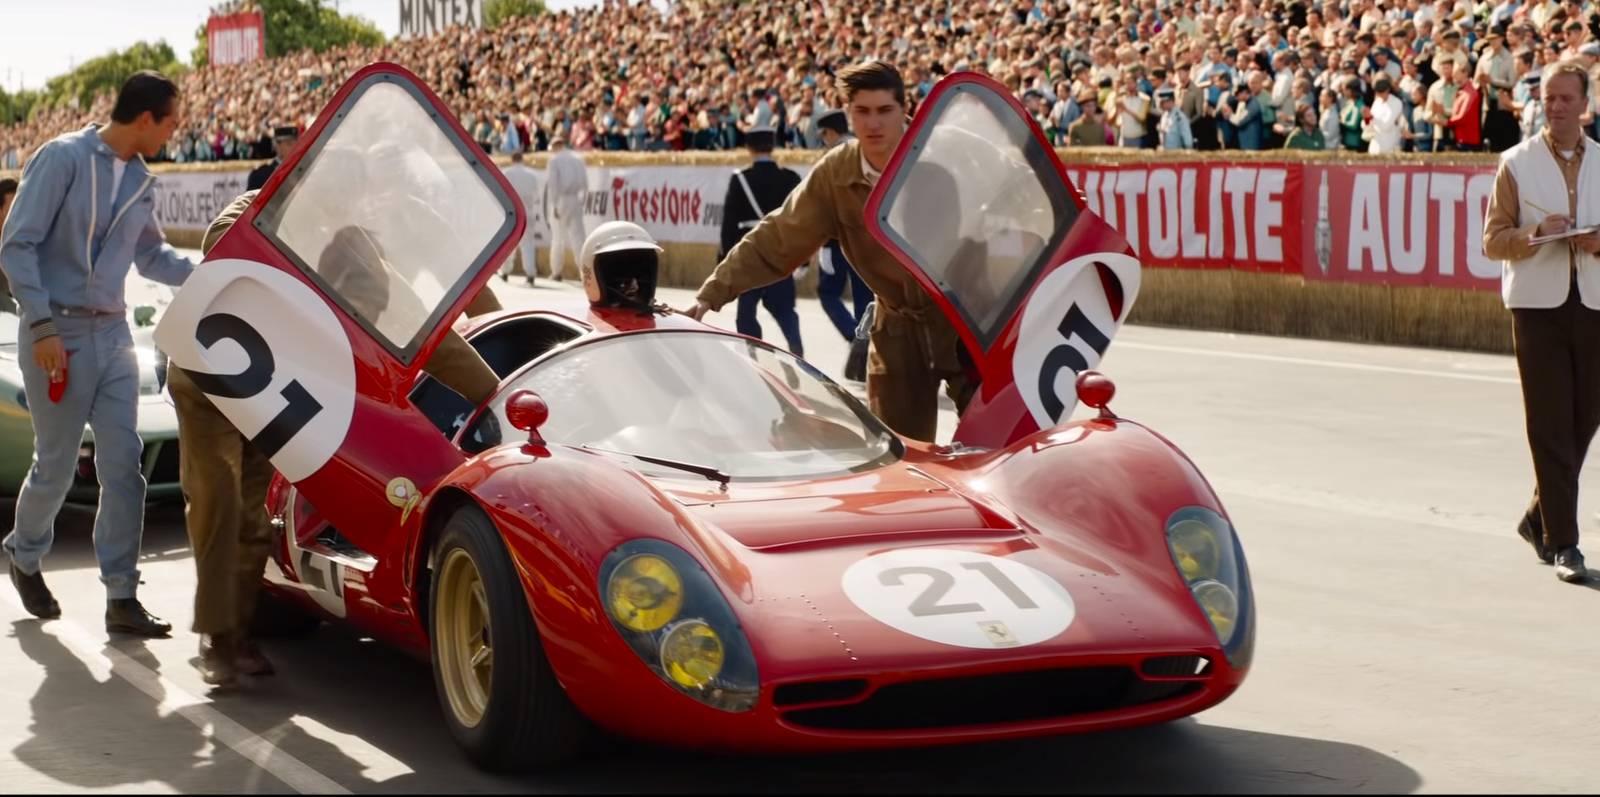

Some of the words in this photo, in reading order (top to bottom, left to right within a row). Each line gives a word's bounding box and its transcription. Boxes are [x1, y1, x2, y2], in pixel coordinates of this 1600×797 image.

[400, 0, 476, 34] MINTEX
[612, 176, 702, 225] Firestone
[181, 313, 324, 462] 21
[878, 561, 1039, 617] 21
